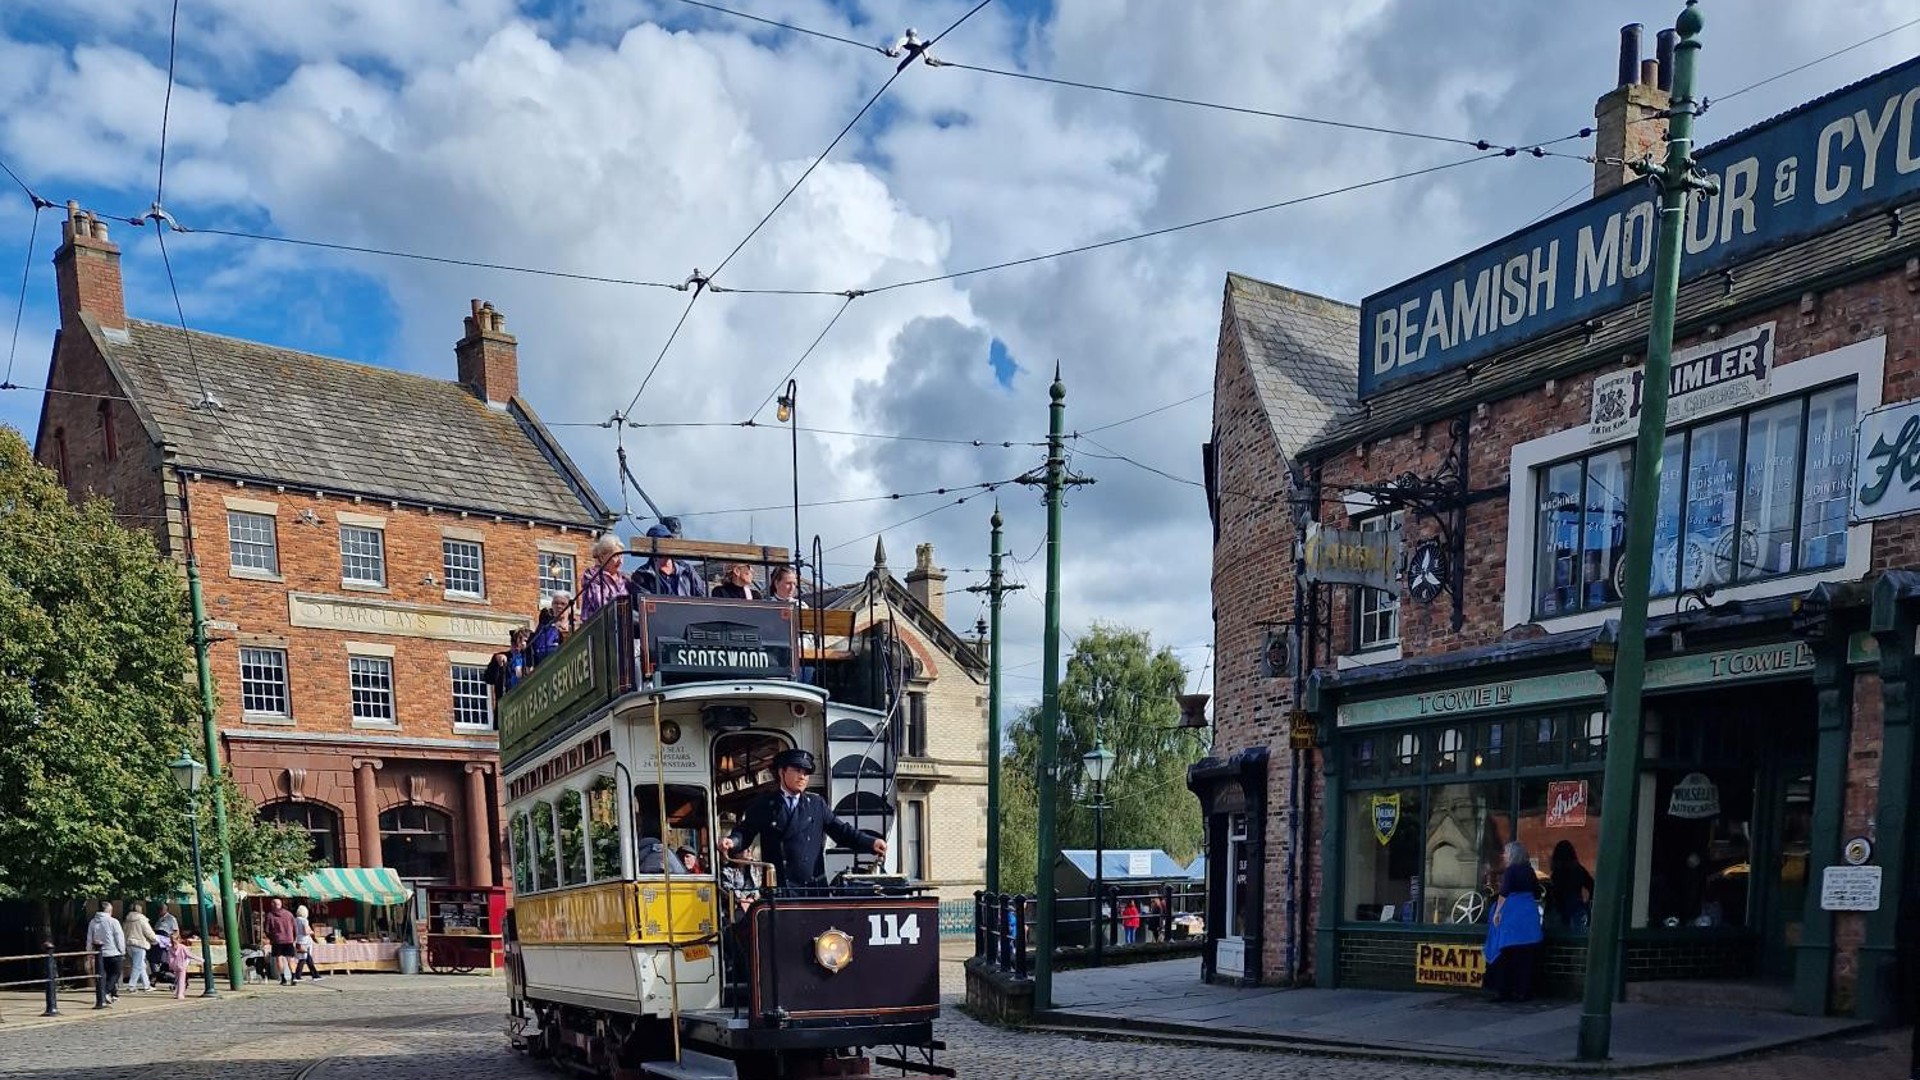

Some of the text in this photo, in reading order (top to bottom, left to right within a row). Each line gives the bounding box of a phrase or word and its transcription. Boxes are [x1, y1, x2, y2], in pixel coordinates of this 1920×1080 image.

[1374, 239, 1560, 376] BEAMISH
[1574, 157, 1760, 300] MOOR
[1773, 155, 1799, 208] &
[1645, 345, 1758, 408] IMLER
[1541, 493, 1580, 511] MACHINES
[331, 604, 497, 637] BARCLAYS BANK
[678, 649, 769, 668] SCOTSWOOD
[1729, 648, 1790, 674] COWIE
[523, 682, 550, 722] YEARS
[552, 649, 590, 702] SERVICE
[1432, 687, 1492, 712] COWIE
[1550, 783, 1584, 821] Ariel
[868, 913, 920, 946] 114
[1419, 968, 1468, 983] PERFECTION
